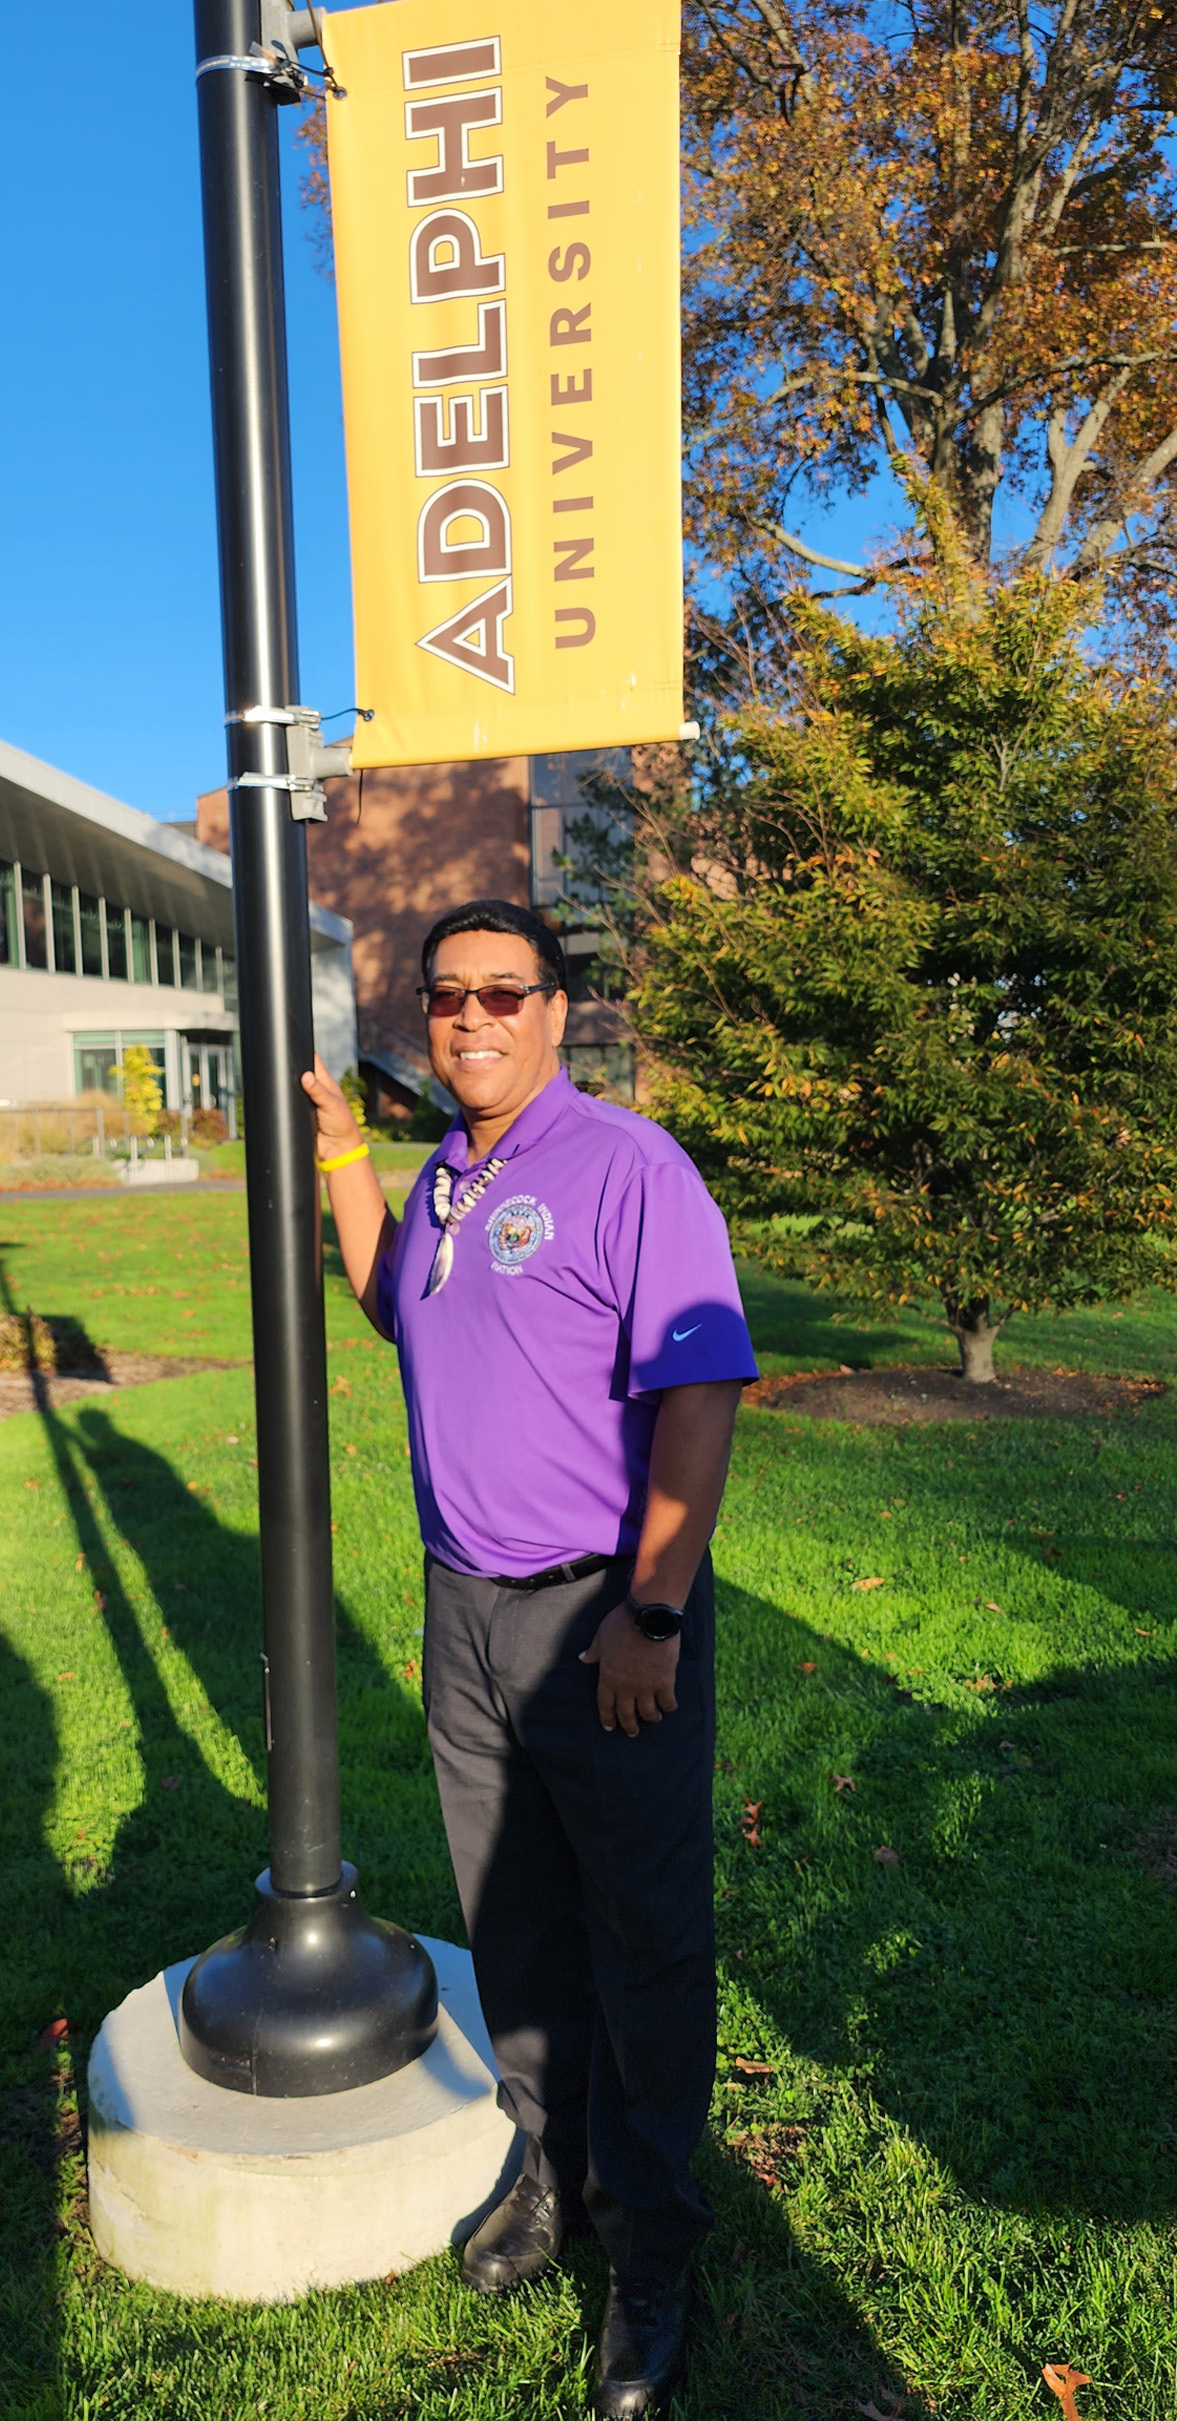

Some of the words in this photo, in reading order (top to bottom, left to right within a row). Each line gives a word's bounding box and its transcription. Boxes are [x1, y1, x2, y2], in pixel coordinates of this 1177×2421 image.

[402, 35, 516, 696] ADELPHI
[546, 76, 596, 649] UNIVERSITY
[537, 1203, 555, 1240] INDIAN
